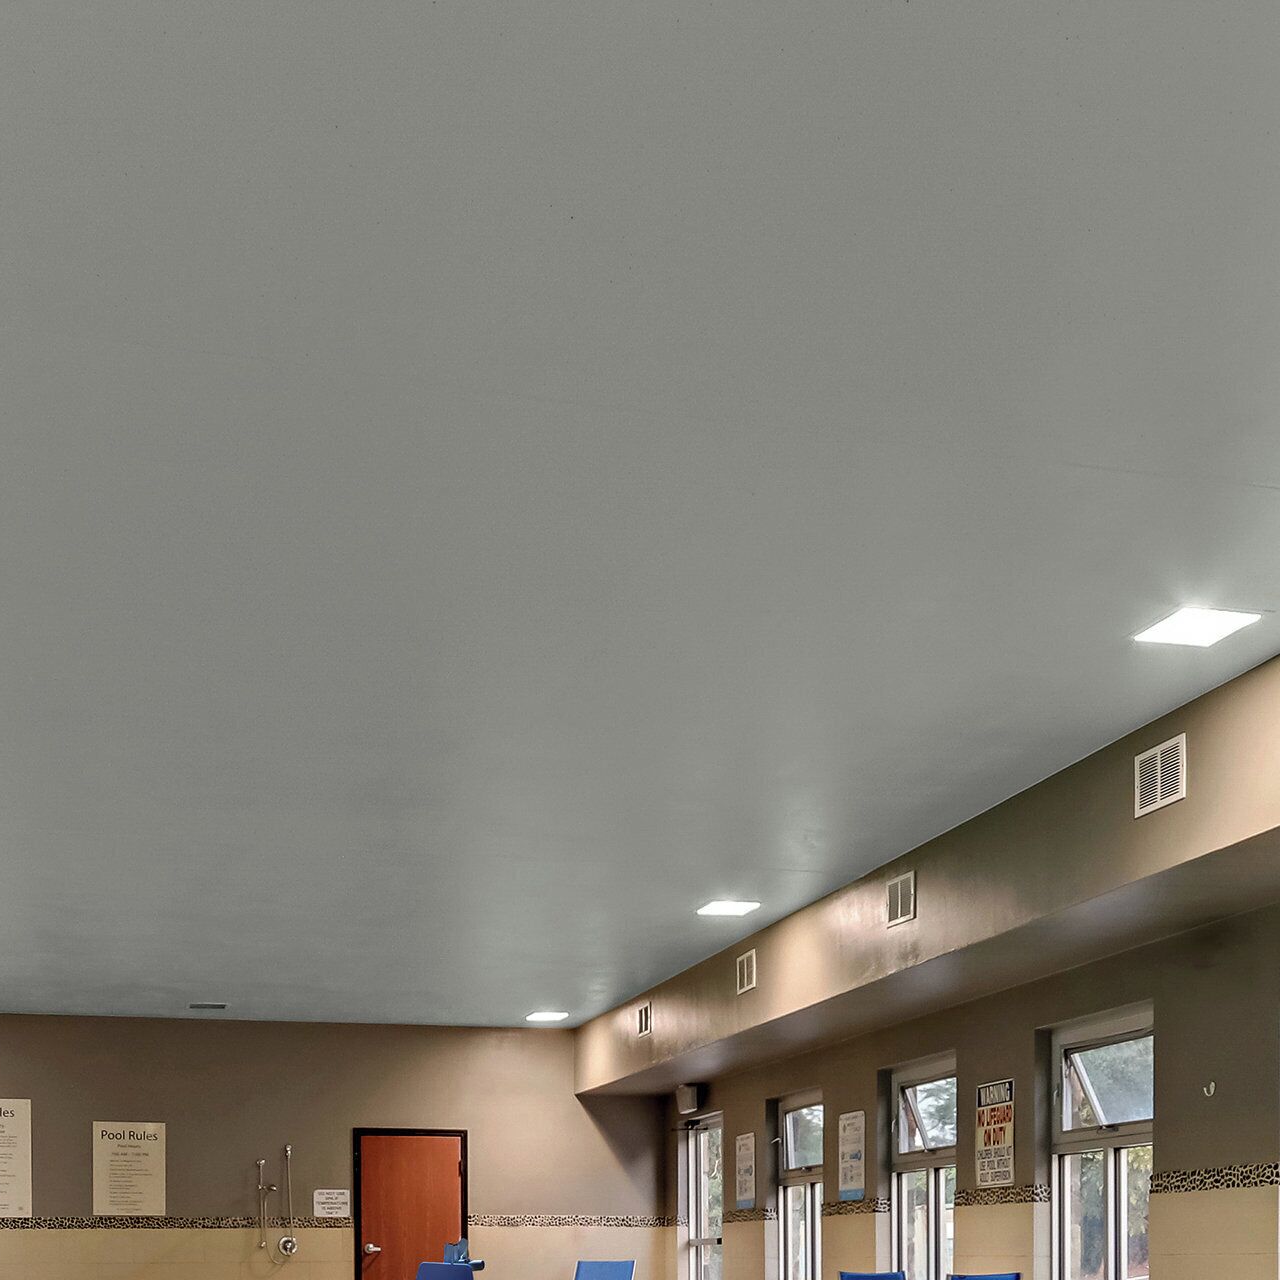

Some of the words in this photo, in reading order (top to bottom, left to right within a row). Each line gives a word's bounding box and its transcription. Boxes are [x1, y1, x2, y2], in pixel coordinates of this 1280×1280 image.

[980, 1082, 1010, 1106] WARNING
[101, 1129, 125, 1140] Pool
[128, 1130, 158, 1140] Rules
